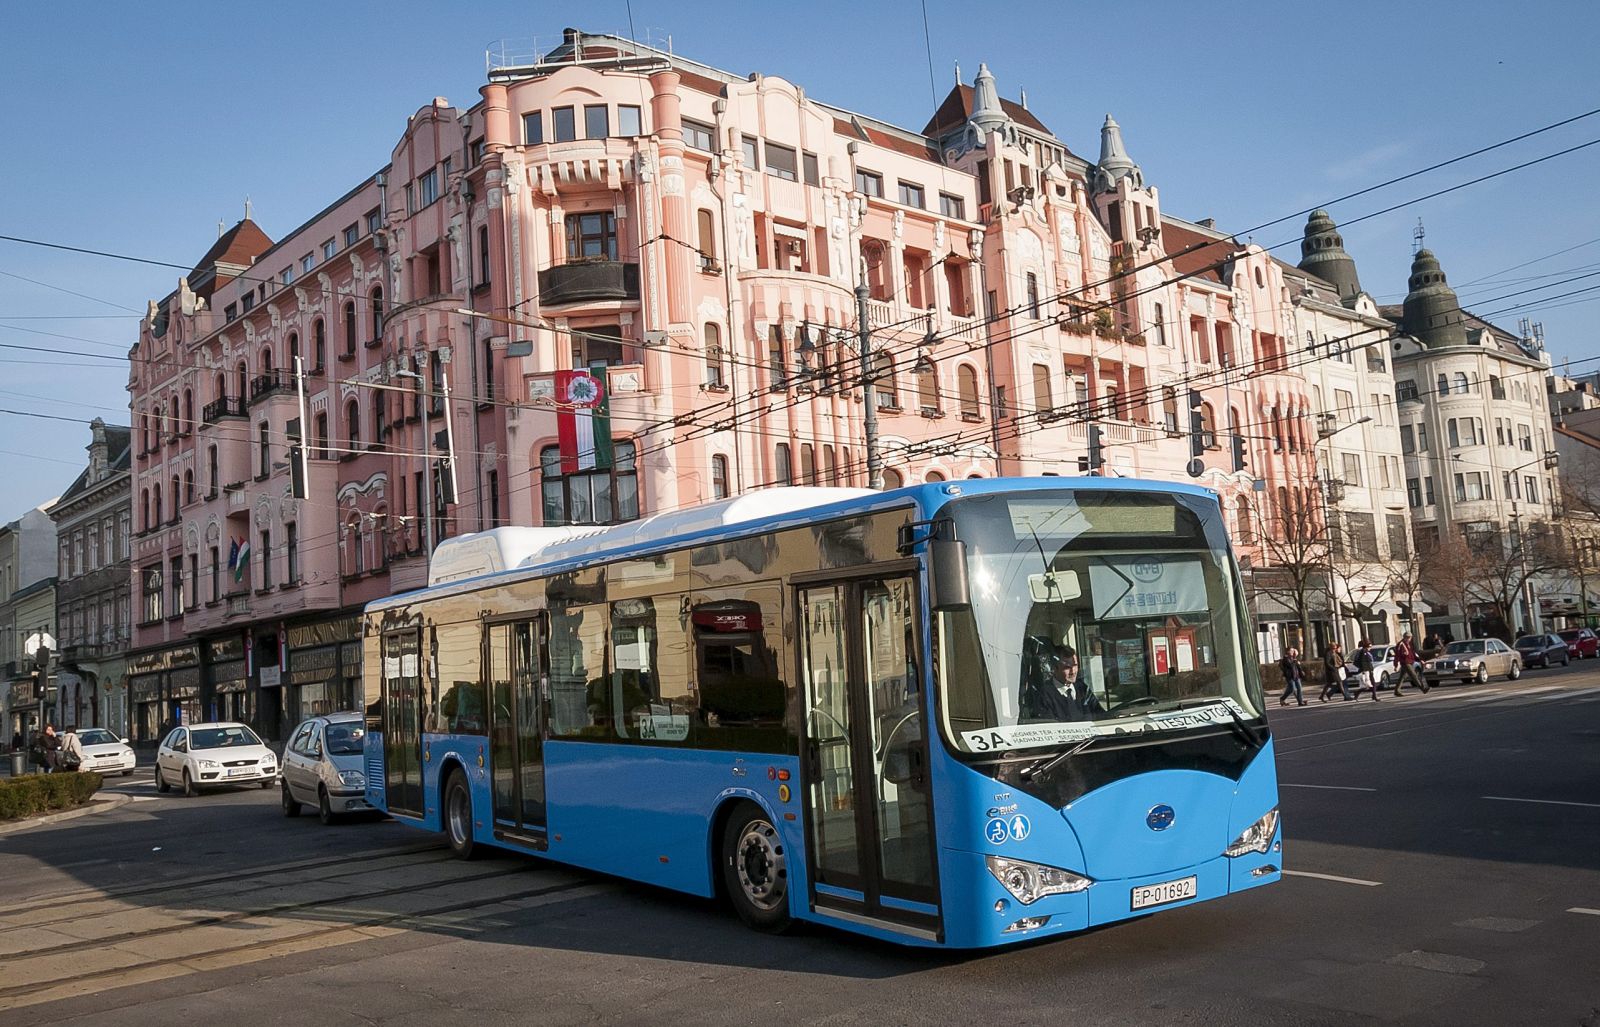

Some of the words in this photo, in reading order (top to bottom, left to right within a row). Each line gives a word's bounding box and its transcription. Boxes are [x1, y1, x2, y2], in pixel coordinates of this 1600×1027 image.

[641, 719, 657, 738] 3A
[971, 732, 1012, 751] 3A
[1143, 881, 1190, 904] P-01692
